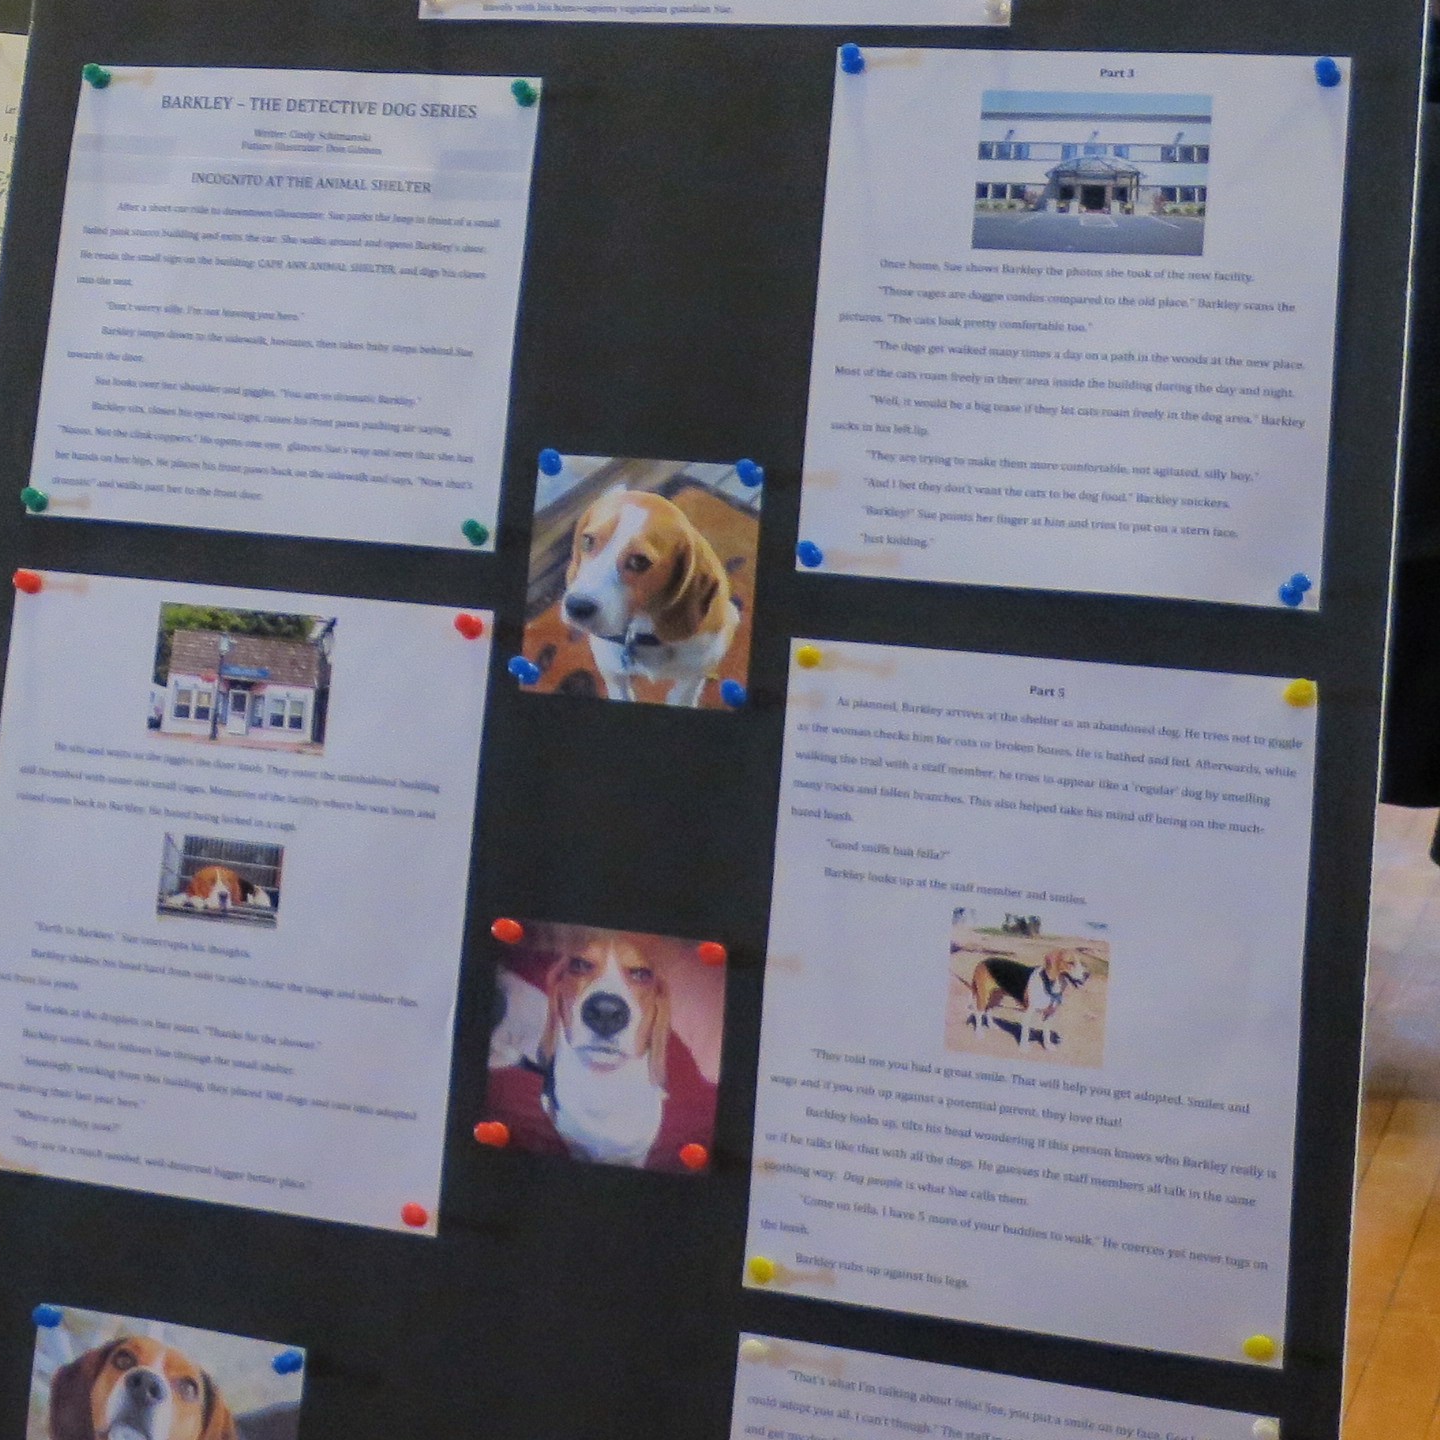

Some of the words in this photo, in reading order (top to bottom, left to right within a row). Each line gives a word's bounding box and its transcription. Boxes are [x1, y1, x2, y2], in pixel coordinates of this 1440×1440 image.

[1100, 68, 1125, 77] Part
[1127, 69, 1134, 77] 3
[161, 95, 234, 110] BARKLEY
[249, 97, 283, 112] THE
[286, 98, 378, 115] DETECTIVE
[382, 102, 417, 117] DOG
[420, 103, 477, 119] SERIES
[192, 172, 262, 185] INCOGNITO
[267, 176, 283, 187] AT
[287, 176, 312, 188] THE
[317, 177, 367, 190] ANIMAL
[371, 179, 431, 193] SHELTER
[1029, 685, 1055, 696] Part
[1058, 688, 1065, 698] 5
